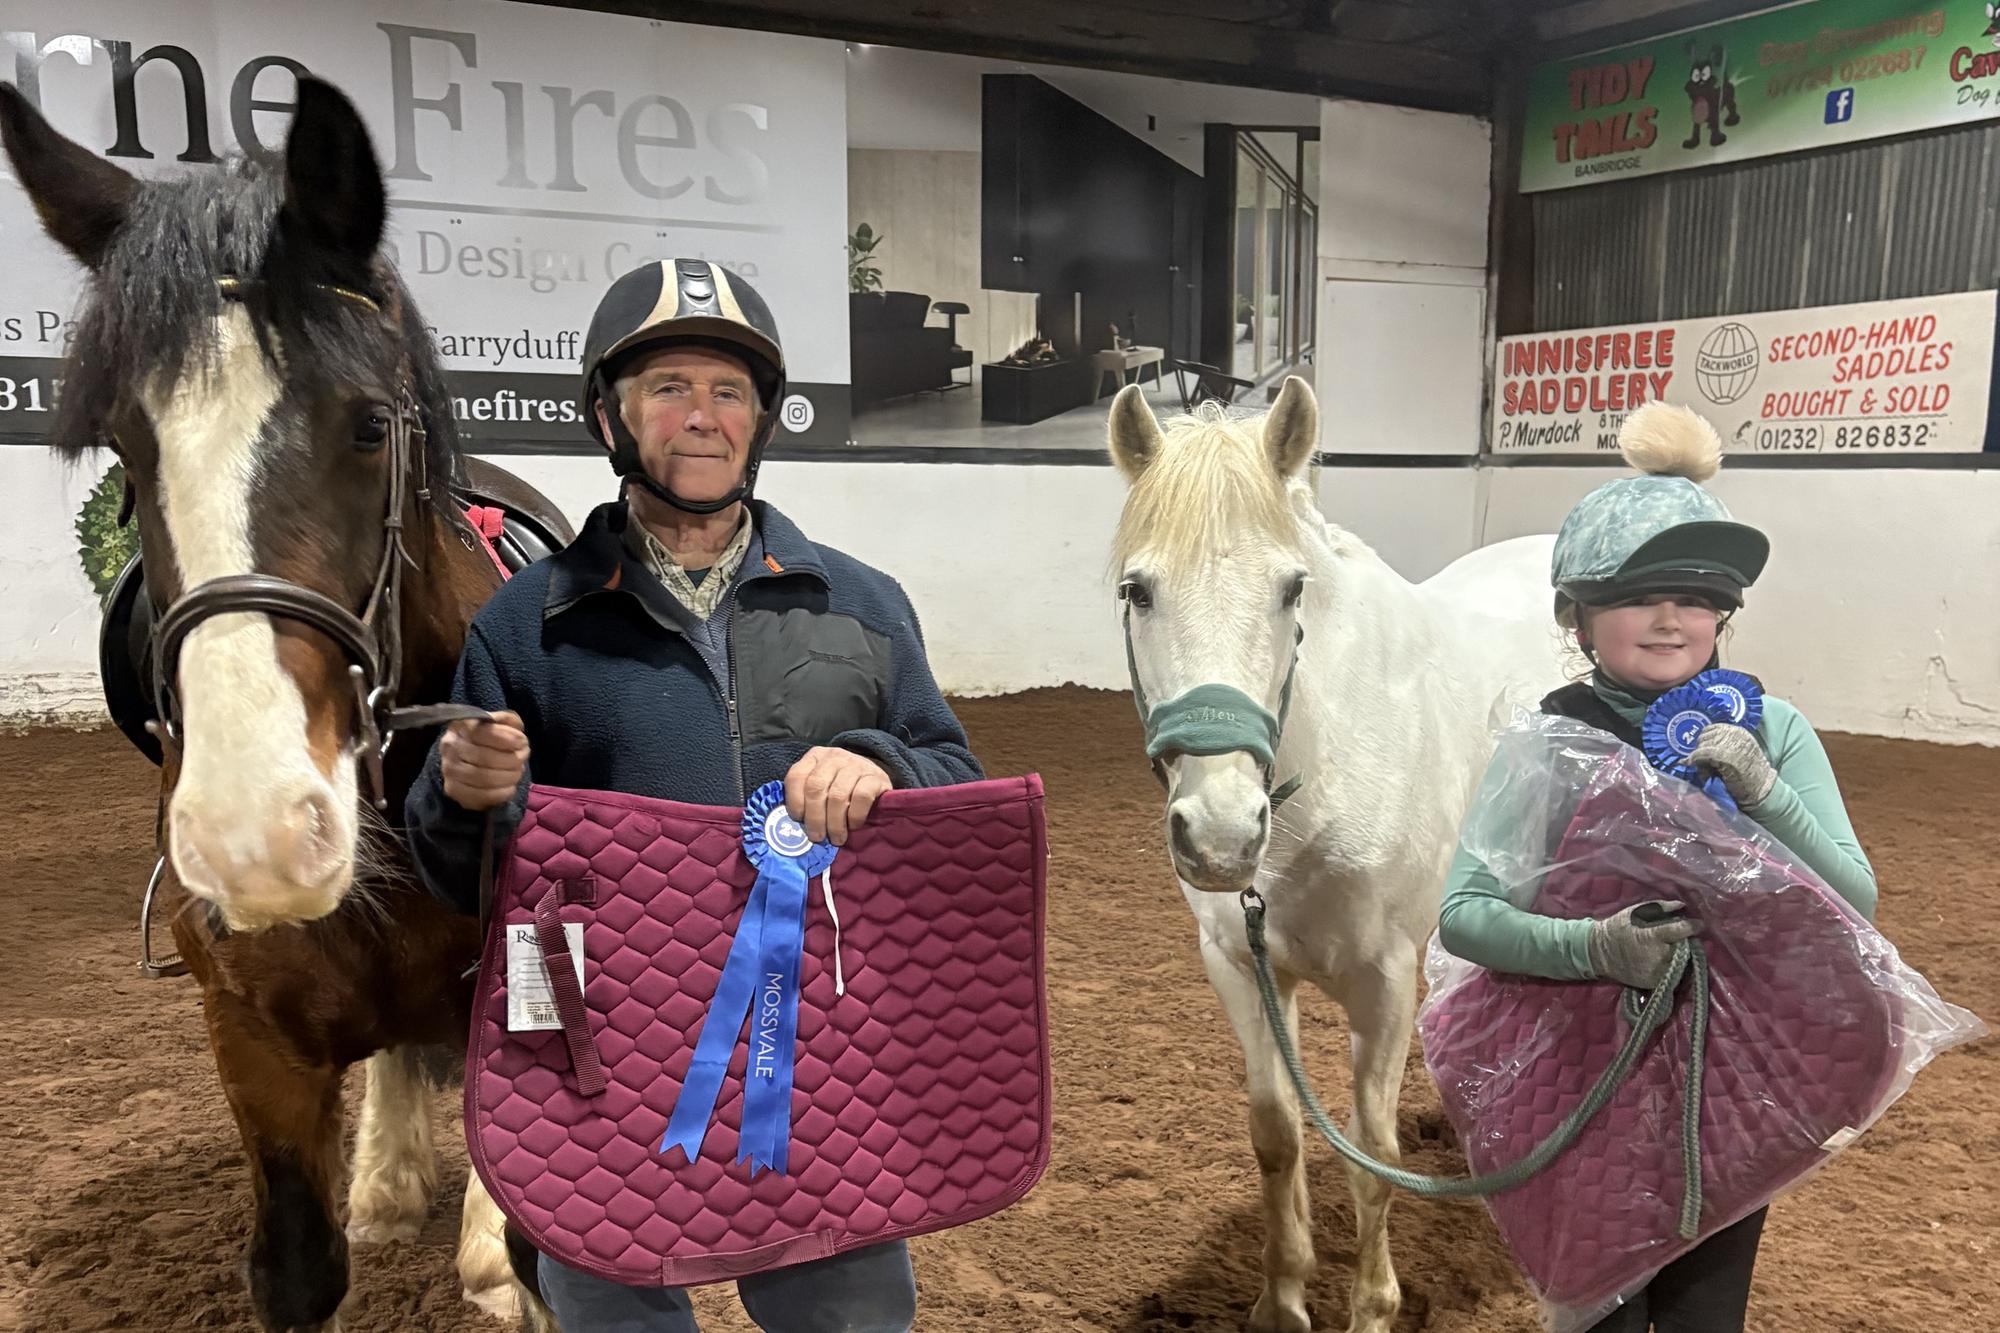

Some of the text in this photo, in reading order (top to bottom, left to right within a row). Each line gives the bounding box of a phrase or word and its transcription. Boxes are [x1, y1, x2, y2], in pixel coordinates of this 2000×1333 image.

[1568, 56, 1654, 111] TIDY
[1957, 84, 1990, 108] Dog
[377, 22, 768, 206] Fires
[1552, 105, 1659, 164] TAILS
[1575, 156, 1642, 177] BANBRIDGE
[417, 230, 589, 294] Design
[425, 326, 584, 366] arryduff,
[1503, 329, 1675, 377] INNISFREE
[1768, 315, 1937, 363] SECOND-HAND
[1700, 353, 1754, 372] TACKWORLD
[1833, 342, 1953, 383] SADDLES
[1503, 371, 1673, 416] SADDLERY
[1761, 384, 1950, 418] BOUGHT & SOLD
[1597, 434, 1621, 449] MO
[1754, 424, 1929, 452] (01232) 826832
[755, 972, 784, 1078] MOSSVALE
